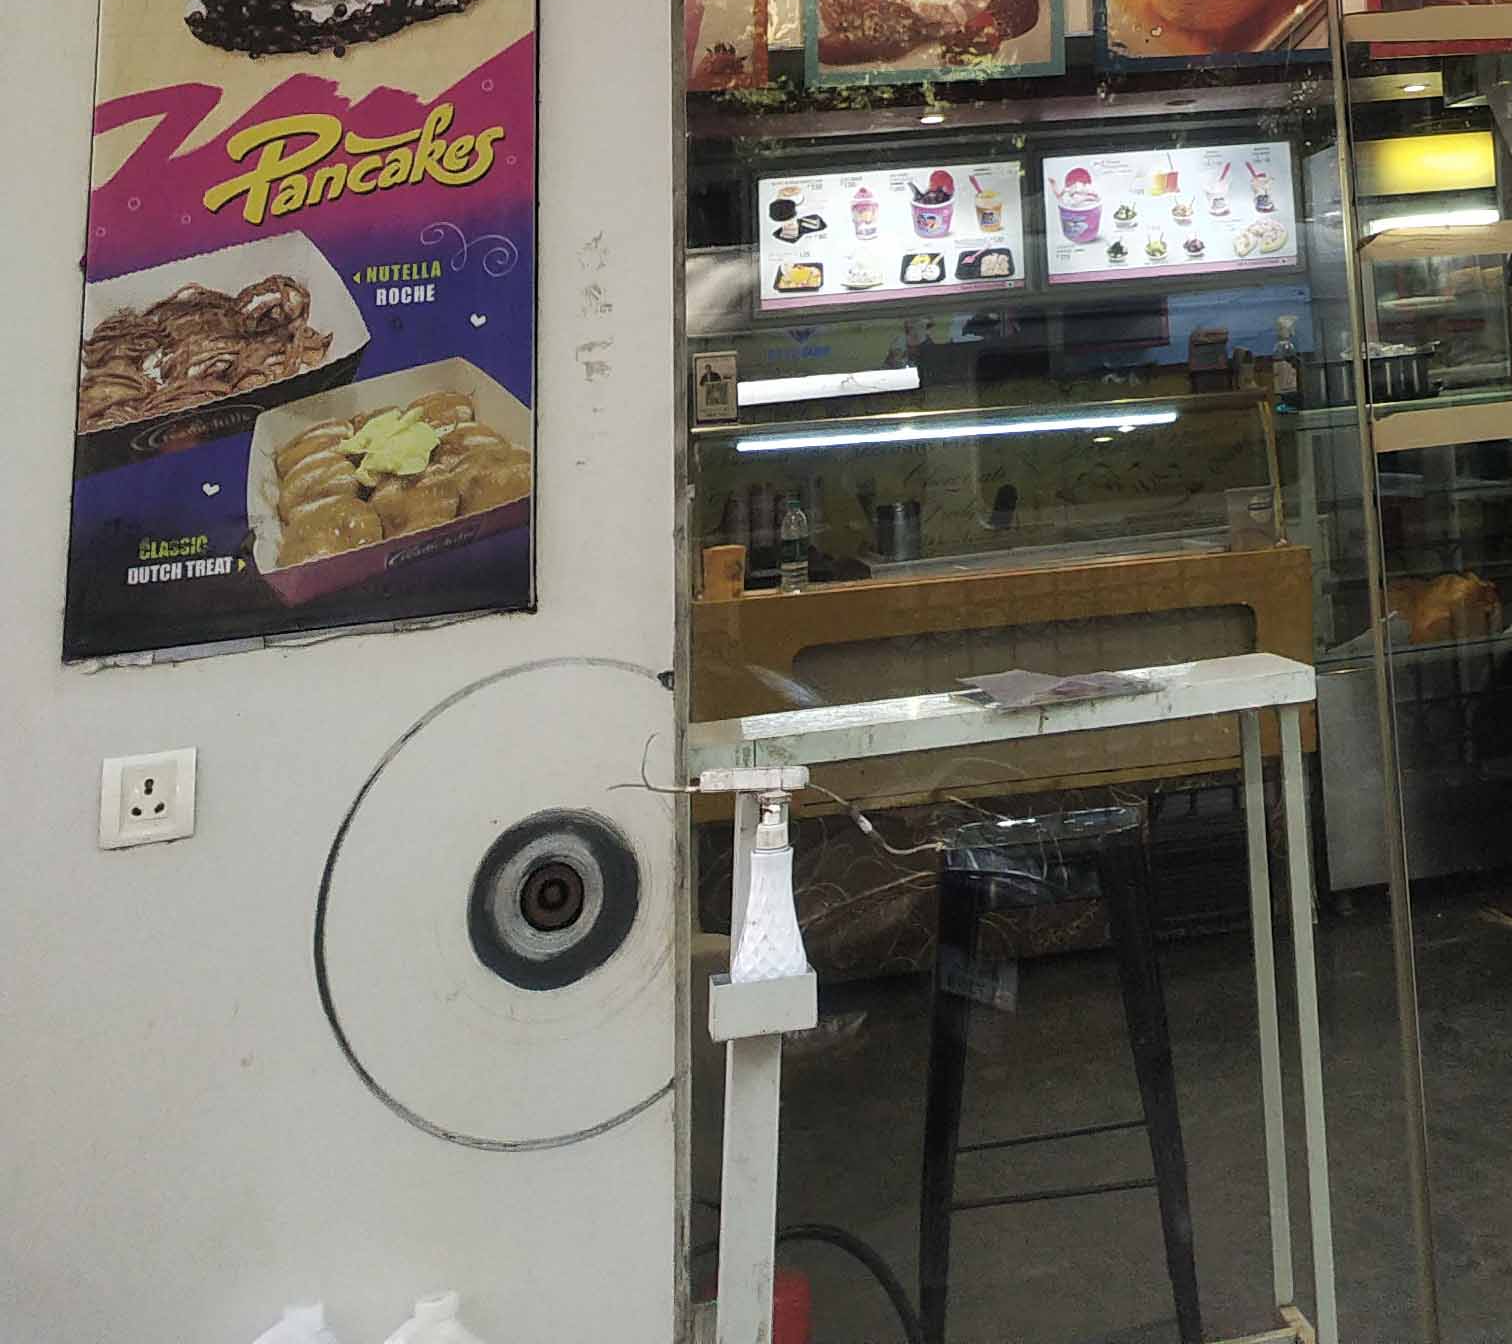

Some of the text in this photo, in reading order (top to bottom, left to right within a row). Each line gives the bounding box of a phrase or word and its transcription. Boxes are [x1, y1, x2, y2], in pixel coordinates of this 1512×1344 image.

[204, 104, 506, 225] Pancakes
[366, 260, 442, 282] NUTELLA
[376, 285, 436, 306] ROCHE
[139, 535, 209, 561] CLASSIC
[127, 556, 234, 585] DUTCH TREAT
